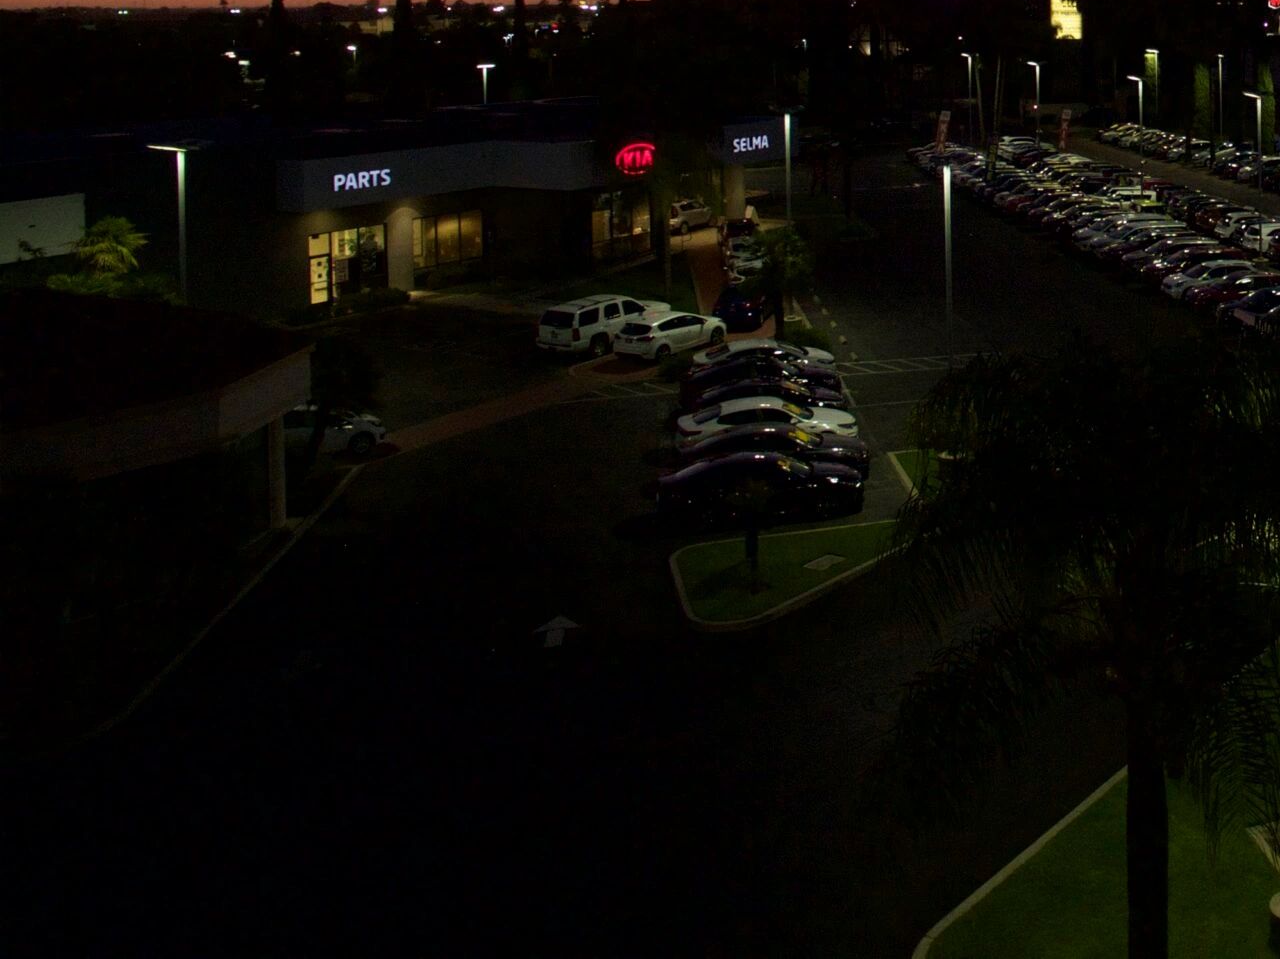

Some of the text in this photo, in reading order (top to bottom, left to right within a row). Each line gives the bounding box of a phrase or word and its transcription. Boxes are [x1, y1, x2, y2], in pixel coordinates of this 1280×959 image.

[733, 135, 769, 153] SELMA
[623, 150, 653, 168] KIA
[333, 168, 391, 191] PARTS
